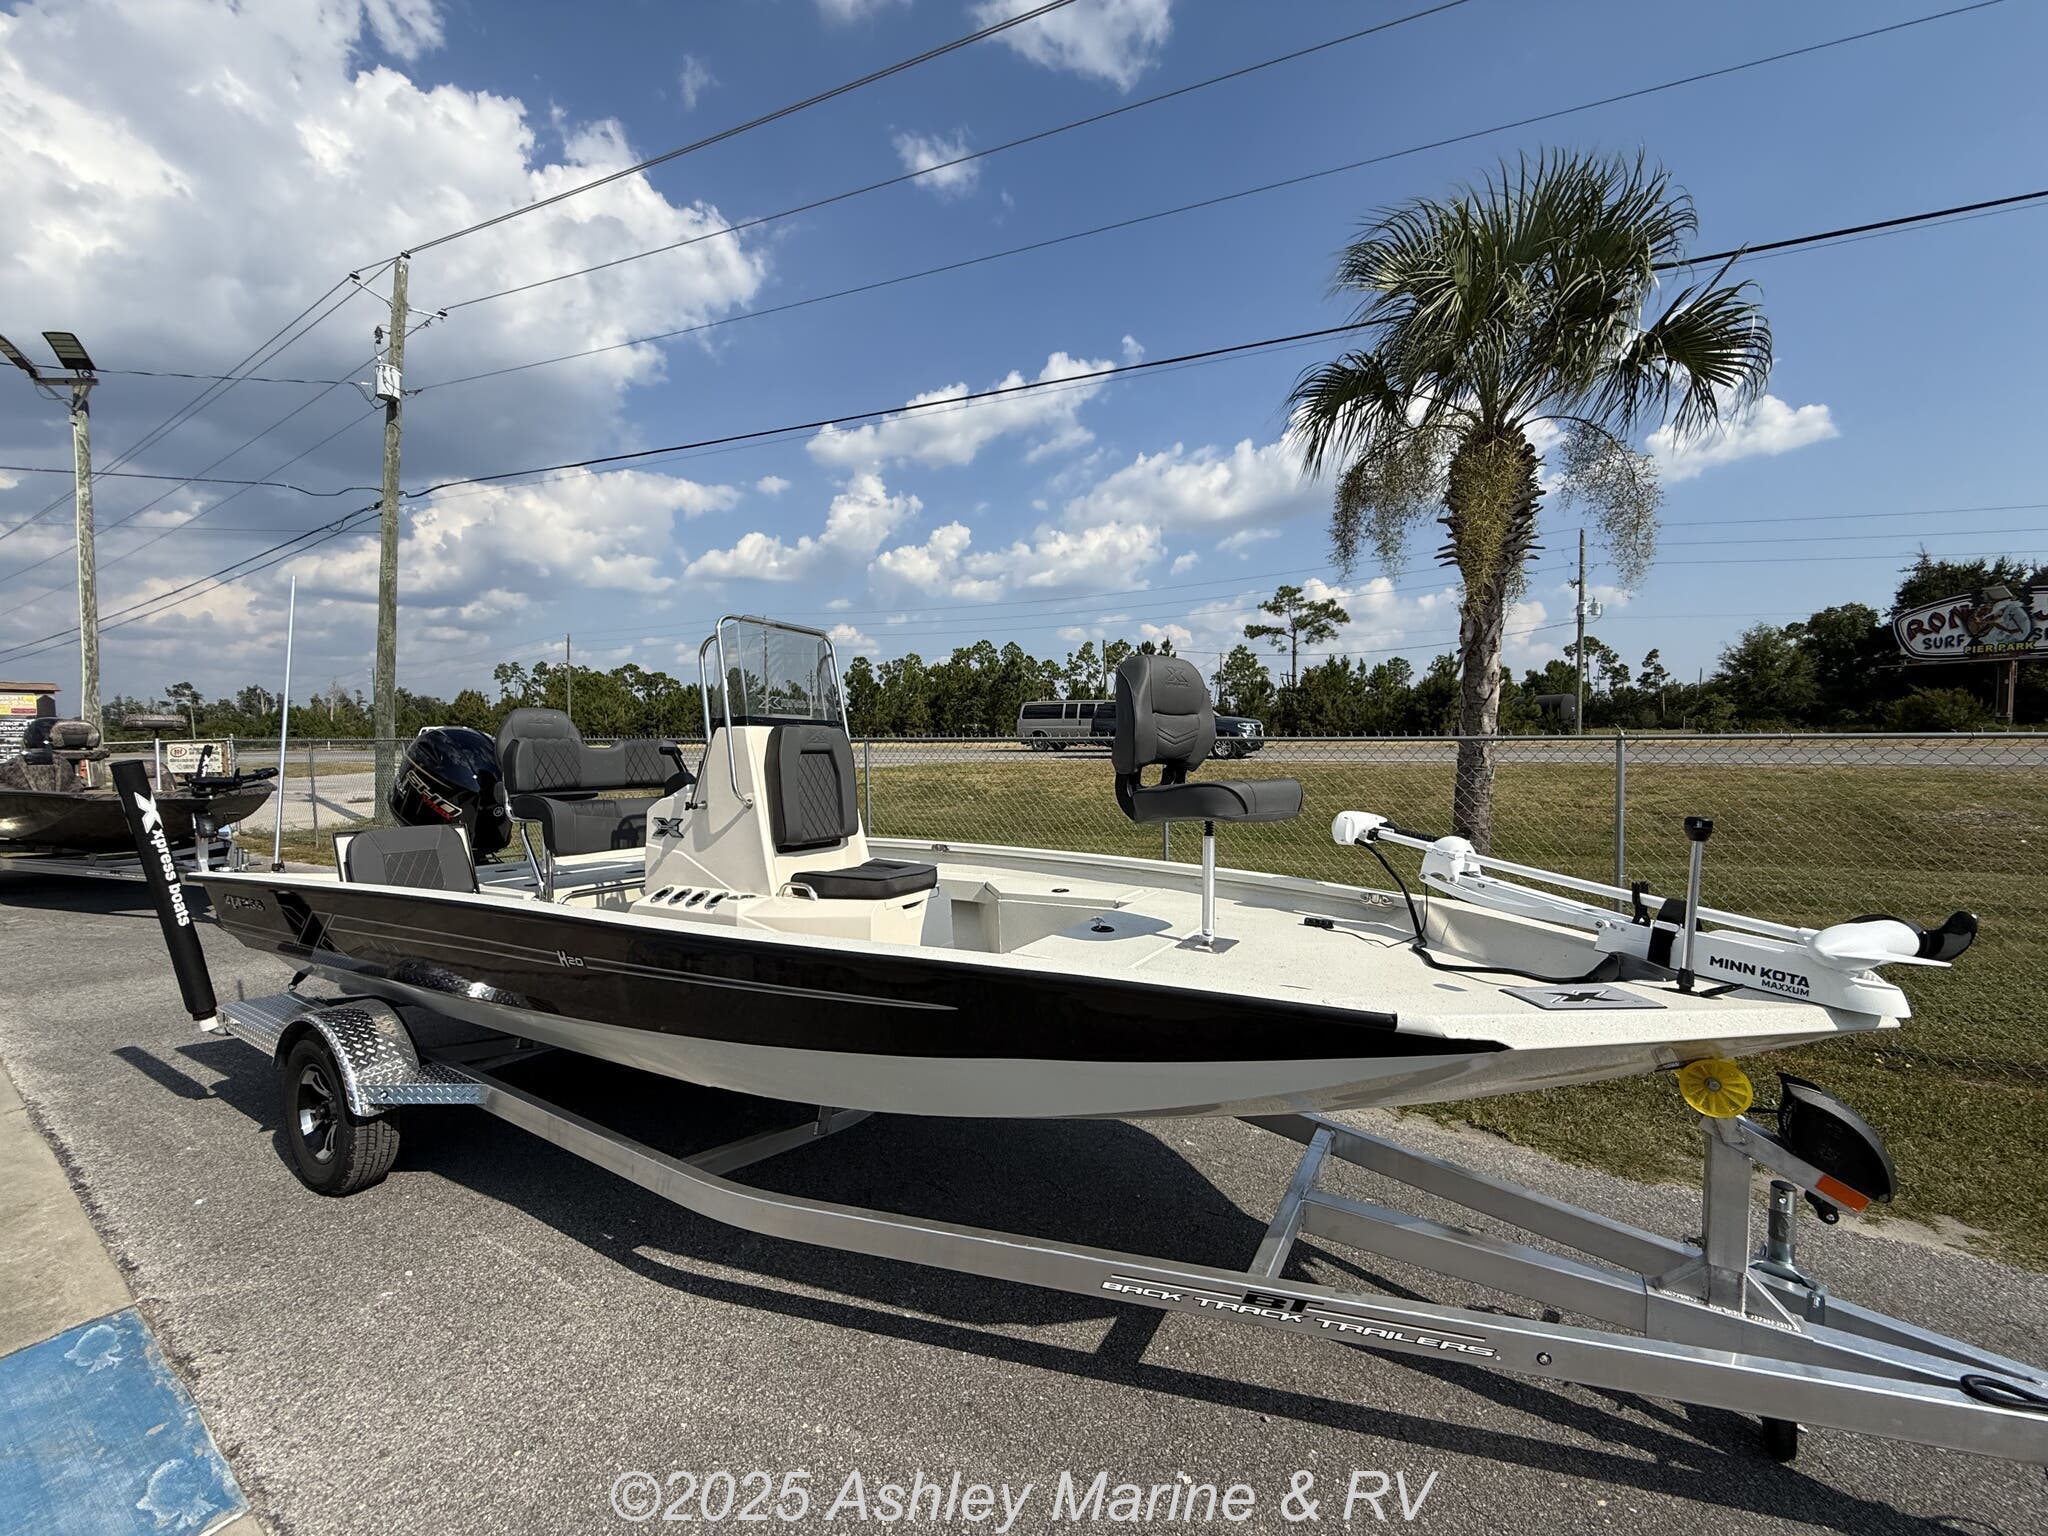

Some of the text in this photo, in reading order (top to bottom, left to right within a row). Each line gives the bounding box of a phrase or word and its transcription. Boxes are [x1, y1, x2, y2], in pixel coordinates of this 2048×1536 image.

[1922, 634, 1965, 650] SURF
[1964, 641, 2034, 654] PIER PARK
[151, 828, 176, 882] xpress
[168, 882, 190, 927] boats
[1709, 955, 1810, 988] MINN KOTA
[1761, 979, 1809, 997] MAXXUM
[1101, 1281, 1187, 1302] BACK
[1194, 1296, 1307, 1324] TRACK
